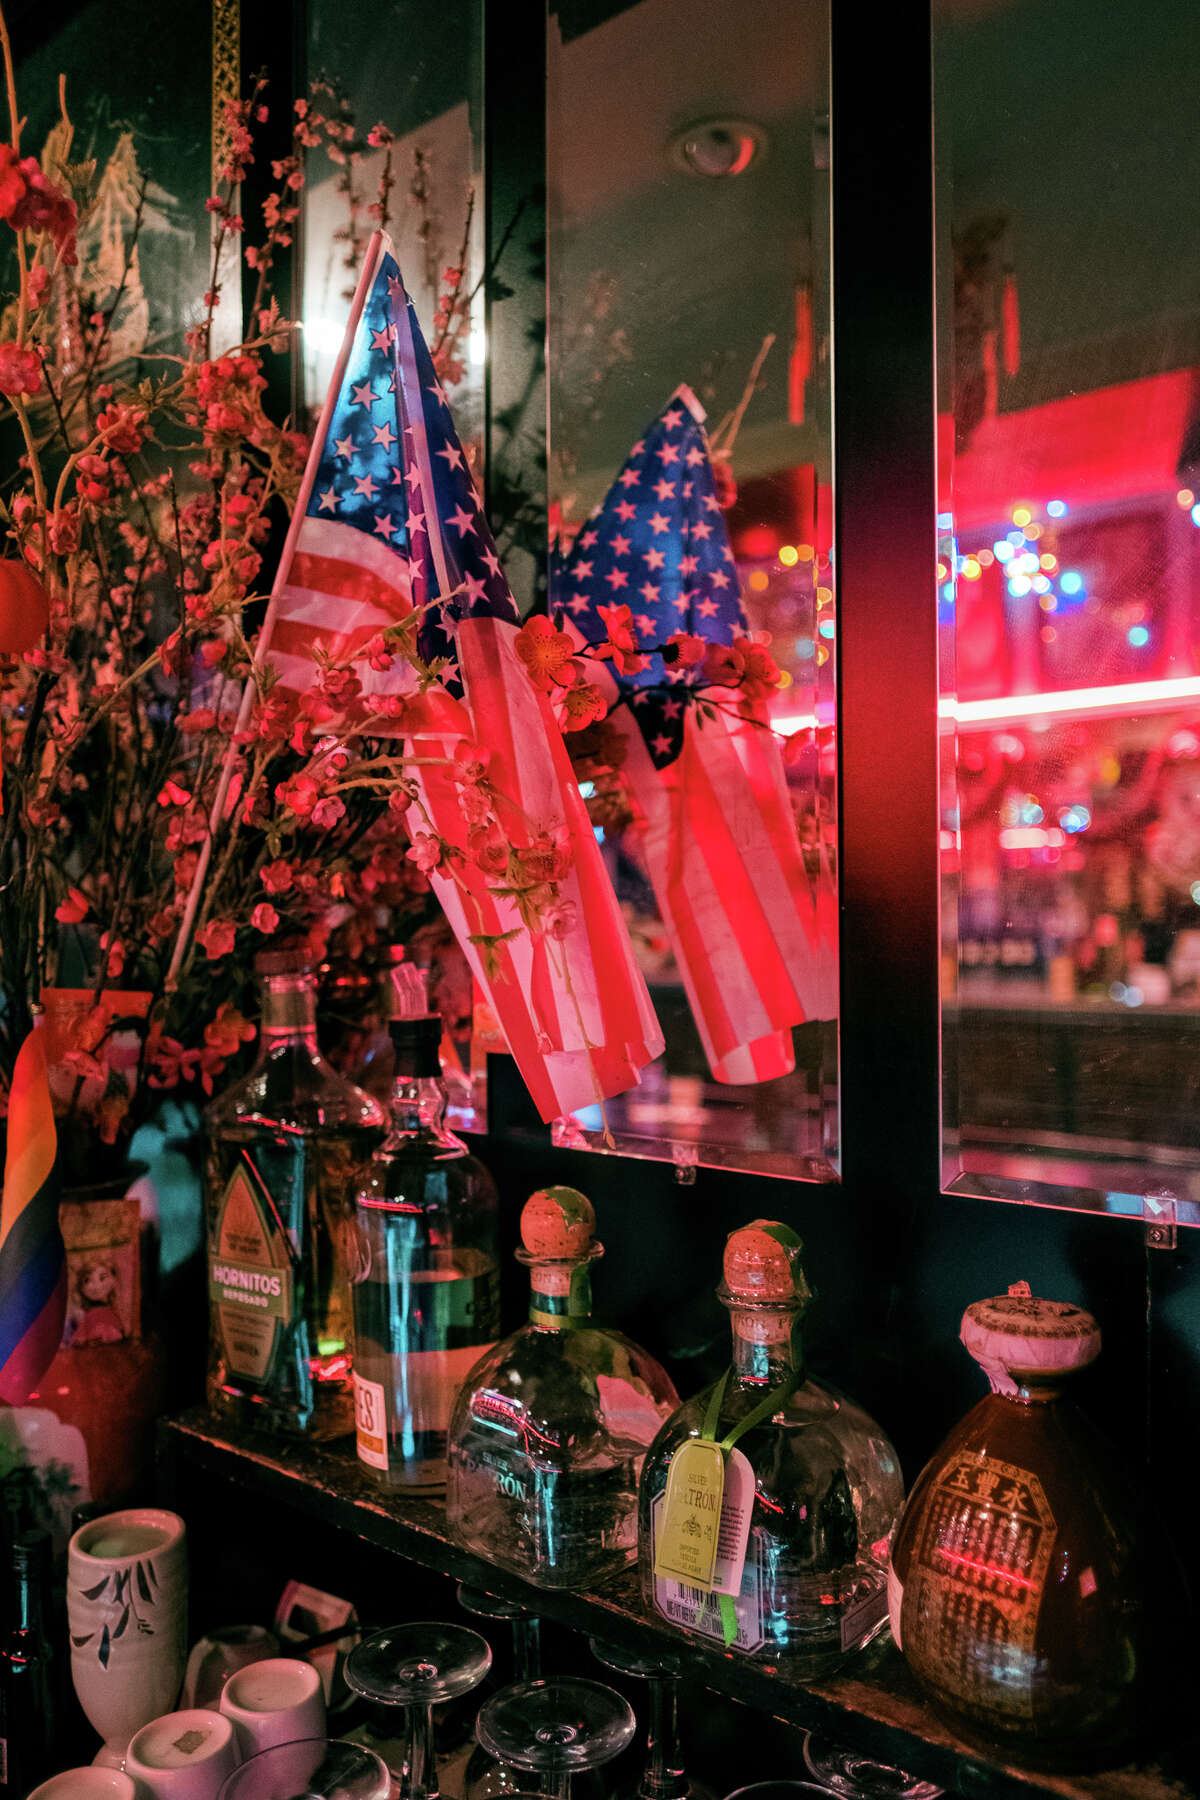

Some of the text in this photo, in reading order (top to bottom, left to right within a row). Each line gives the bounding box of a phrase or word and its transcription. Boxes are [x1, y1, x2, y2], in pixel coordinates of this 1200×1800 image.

[212, 1264, 281, 1297] HORNITOS
[223, 1289, 269, 1308] REPOSADO
[467, 1457, 528, 1503] PRÓN
[673, 1487, 716, 1512] ATRÓN
